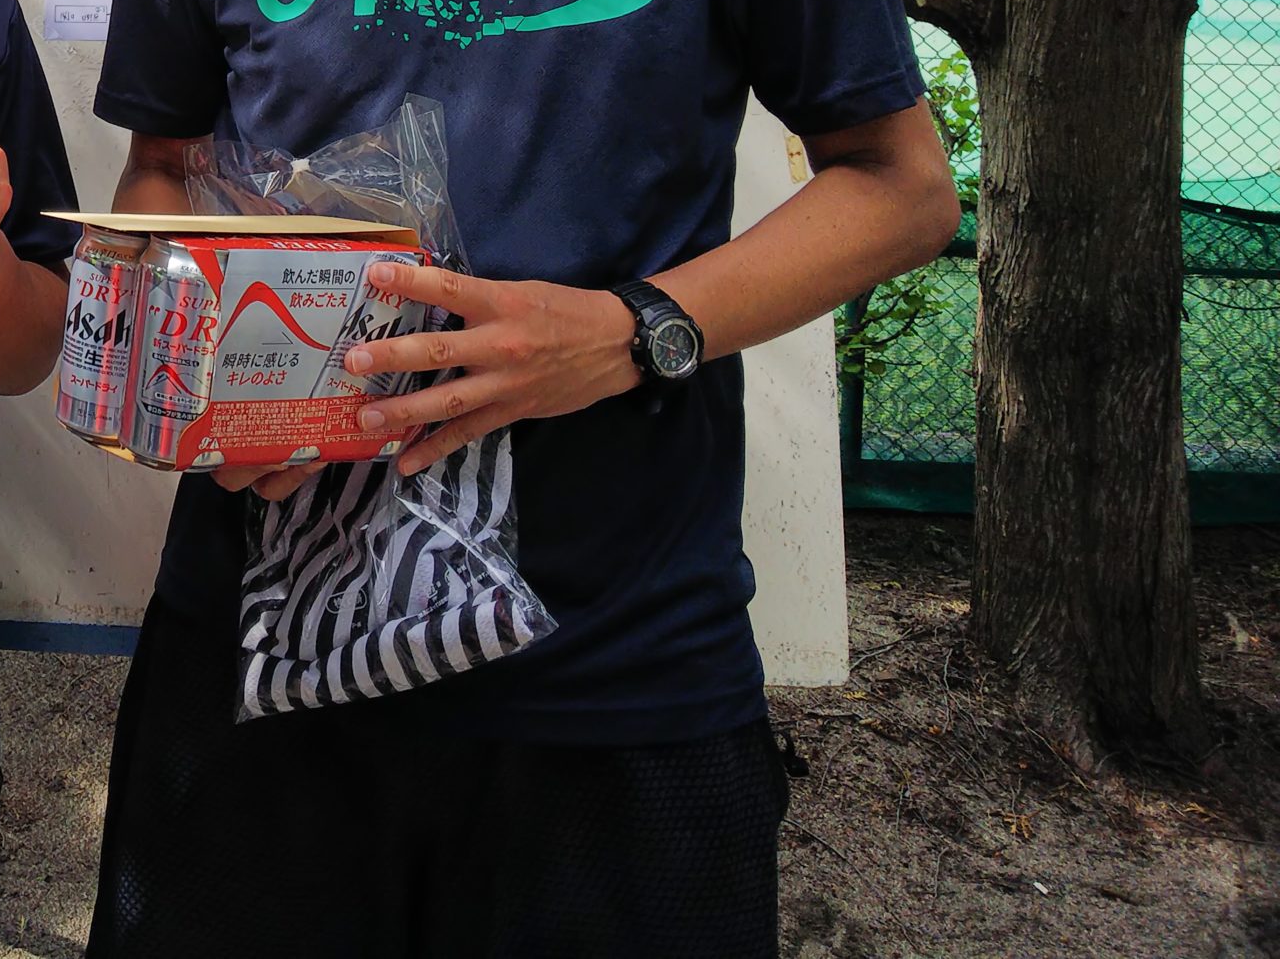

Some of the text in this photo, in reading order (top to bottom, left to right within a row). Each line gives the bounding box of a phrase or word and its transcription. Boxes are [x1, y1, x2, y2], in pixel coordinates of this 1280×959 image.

[281, 268, 357, 286] 飲んだ瞬間の
[288, 292, 349, 309] 飲みごたえ
[84, 349, 104, 369] 生
[221, 352, 300, 369] 瞬時に感じる
[70, 374, 119, 393] スーパードライ
[225, 370, 289, 387] キレのよさ
